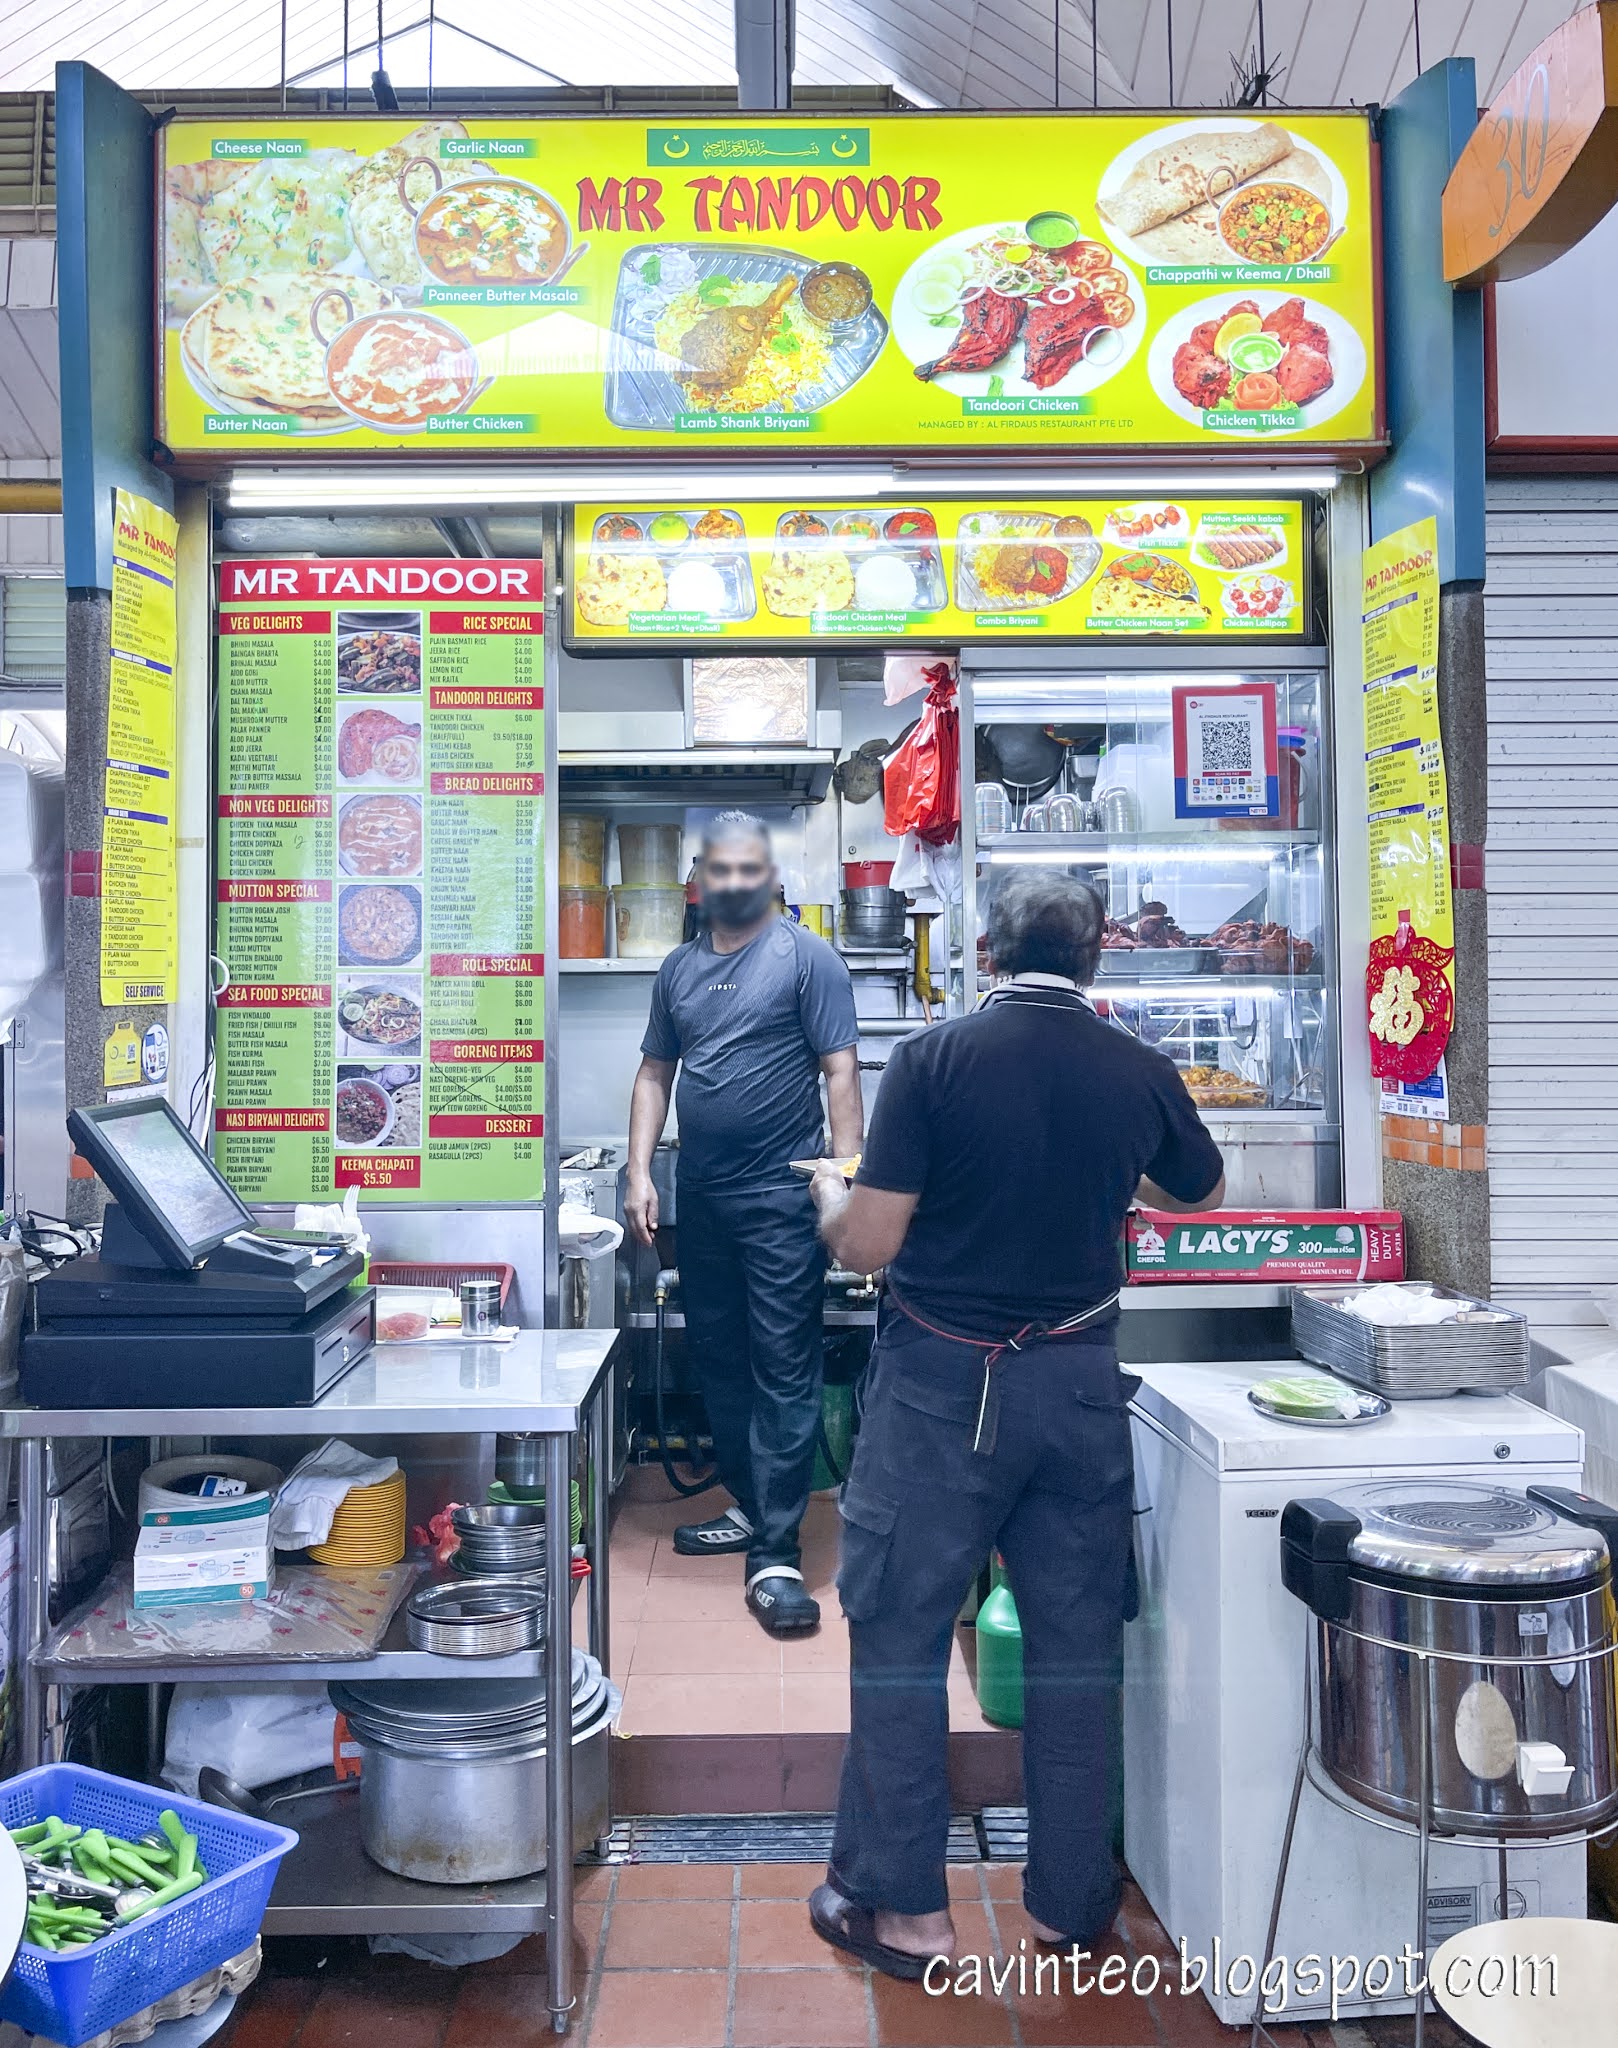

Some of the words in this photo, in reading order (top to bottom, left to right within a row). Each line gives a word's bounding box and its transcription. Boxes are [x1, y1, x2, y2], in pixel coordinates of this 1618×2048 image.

[214, 140, 262, 155] Cheese
[264, 140, 302, 154] Naan
[446, 140, 485, 155] Garlic
[488, 140, 524, 155] Naan
[577, 176, 666, 233] MR
[684, 174, 943, 233] TANDOOR
[1148, 266, 1217, 284] Chappathi
[1220, 271, 1232, 280] w
[1236, 266, 1282, 280] Keema
[1285, 266, 1294, 282] /
[1296, 266, 1330, 280] Dhall
[428, 288, 482, 303] Panneer
[486, 288, 524, 302] Butter
[529, 288, 578, 302] Masala
[968, 398, 1026, 412] Tandoori
[1029, 398, 1079, 412] Chicken
[208, 418, 250, 432] Butter
[252, 418, 288, 432] Naan
[429, 416, 470, 431] Butter
[474, 416, 523, 430] Chicken
[680, 416, 714, 430] Lamb
[718, 415, 761, 430] Shank
[764, 414, 809, 431] Briyani
[1001, 420, 1037, 428] FIRDAUS
[1040, 420, 1096, 428] RESTAURANT
[1206, 414, 1255, 428] Chicken
[1260, 414, 1296, 428] Tikka
[1203, 515, 1229, 523] Mutton
[1232, 515, 1256, 523] Seekh
[1258, 515, 1284, 523] kabab
[119, 522, 139, 541] MR
[144, 531, 177, 561] TANDO
[1366, 574, 1377, 592] MR
[1380, 550, 1432, 583] TANDOOR
[233, 569, 299, 595] MR
[309, 567, 529, 594] TANDOOR
[231, 617, 250, 629] VEG
[253, 616, 303, 629] DELIGHTS
[464, 616, 487, 630] RICE
[490, 617, 532, 630] SPECIAL
[630, 613, 676, 623] Vegetarian
[678, 613, 700, 622] Meal
[812, 613, 848, 622] Tandoori
[851, 613, 882, 622] Chicken
[885, 613, 907, 622] Meal
[976, 616, 1006, 625] Combo
[1009, 616, 1038, 627] Briyani
[1087, 619, 1112, 627] Butter
[1115, 619, 1147, 627] Chicken
[1150, 619, 1172, 627] Naan
[1175, 619, 1188, 627] Set
[1224, 619, 1253, 627] Chicken
[1256, 619, 1287, 628] Lollipop
[435, 691, 484, 705] TANDOORI
[489, 692, 533, 705] DELIGHTS
[445, 778, 479, 790] BREAD
[483, 778, 533, 790] DELIGHTS
[230, 800, 251, 813] NON
[255, 800, 275, 813] VEG
[278, 800, 328, 812] DELIGHTS
[229, 885, 273, 898] MUTTON
[277, 884, 319, 897] SPECIAL
[462, 959, 485, 971] ROLL
[491, 959, 533, 972] SPECIAL
[126, 985, 138, 997] SELF
[140, 985, 164, 997] SERVICE
[708, 983, 737, 991] KIPSTA
[228, 988, 247, 1001] SEA
[250, 988, 279, 1001] FOOD
[282, 988, 324, 1001] SPECIAL
[454, 1045, 497, 1058] GORENG
[501, 1045, 533, 1058] ITEMS
[226, 1113, 246, 1126] NASI
[248, 1113, 282, 1126] BIRYANI
[285, 1113, 325, 1126] DELIGHTS
[486, 1120, 532, 1133] DESSERT
[514, 1142, 532, 1150] $4.00
[342, 1159, 373, 1171] KEEMA
[375, 1159, 414, 1171] CHAPATI
[363, 1172, 392, 1185] $5.50
[1179, 1230, 1289, 1254] LACY'S
[1297, 1241, 1322, 1253] 300
[1370, 1230, 1379, 1262] HEAVY
[1383, 1232, 1391, 1259] DUTY
[242, 1586, 252, 1594] 50
[1428, 1897, 1471, 1906] ADVISORY
